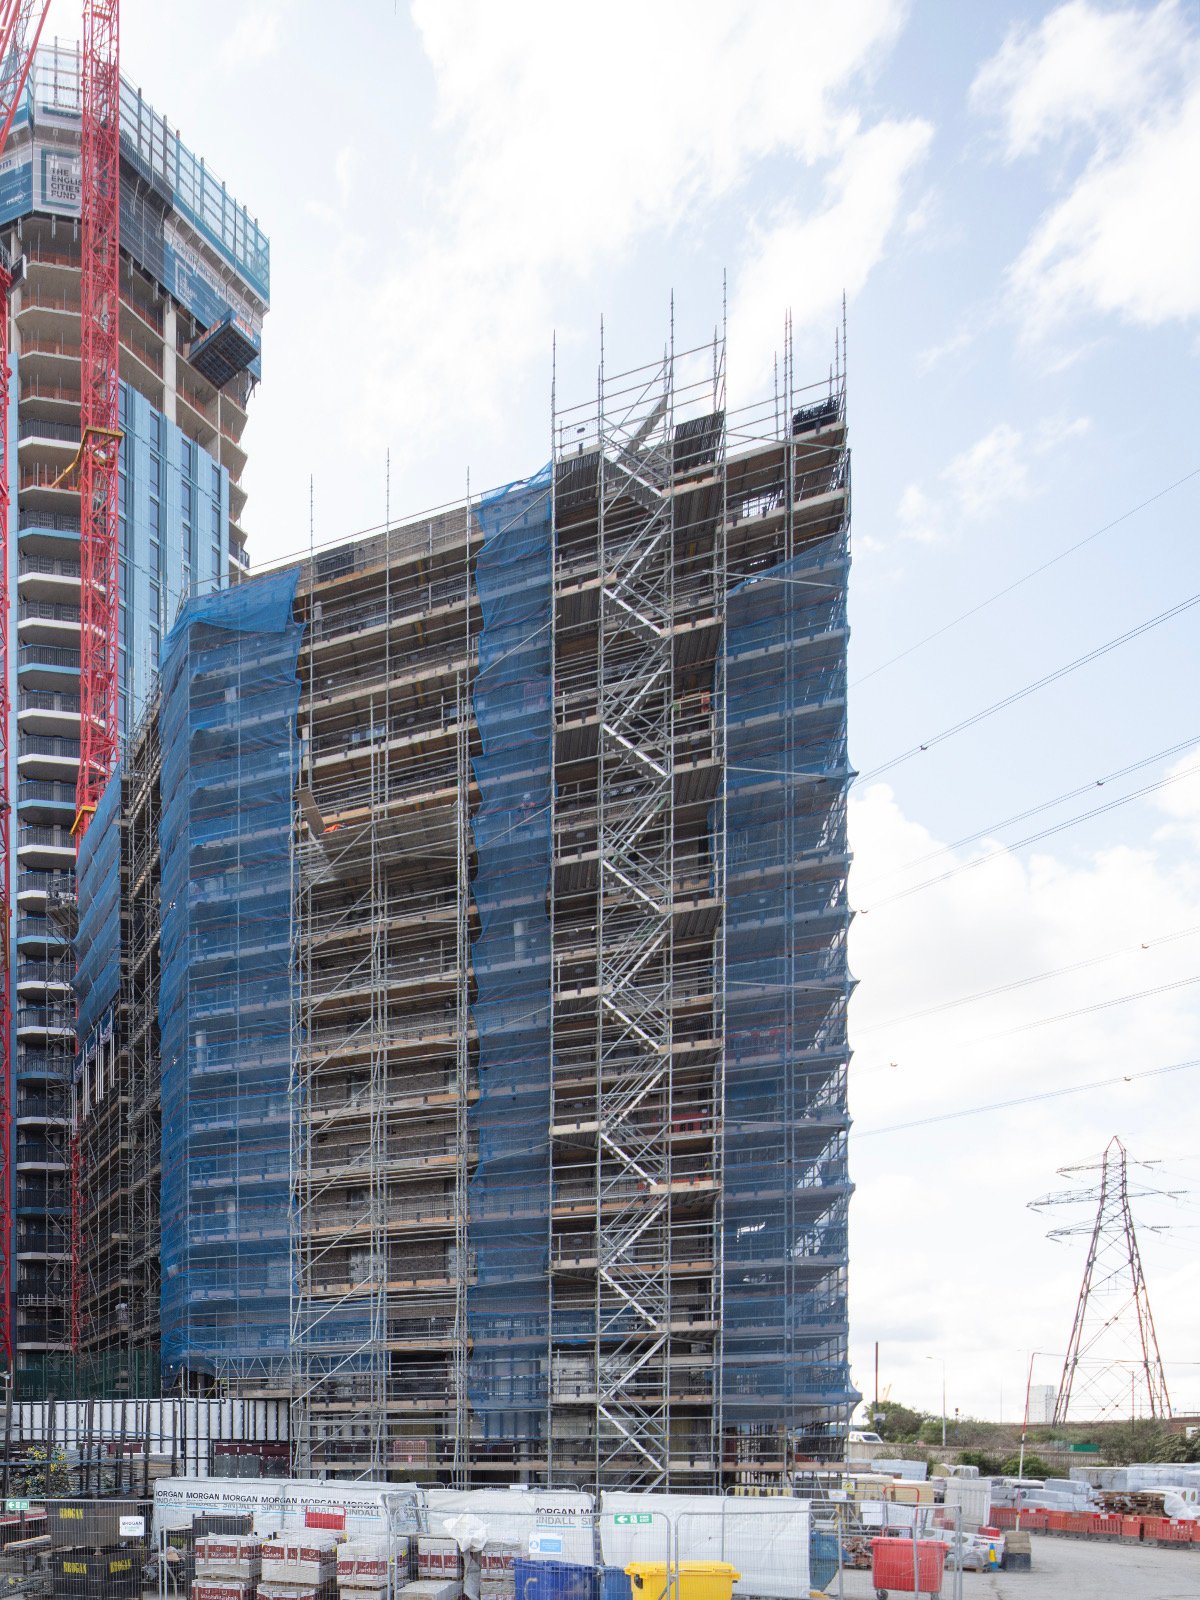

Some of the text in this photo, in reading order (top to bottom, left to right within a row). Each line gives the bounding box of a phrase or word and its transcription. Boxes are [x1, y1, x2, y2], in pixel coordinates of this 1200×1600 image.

[51, 167, 69, 177] THE
[51, 174, 82, 187] ENGLIS
[51, 182, 80, 194] CITIES
[51, 190, 76, 201] FUND
[186, 1491, 220, 1501] MORGAN
[222, 1493, 258, 1503] MORGAN
[260, 1496, 298, 1504] MORGAN
[59, 1507, 84, 1520] BROGAN
[63, 1561, 87, 1575] BROGAN
[109, 1558, 132, 1574] BROGAN
